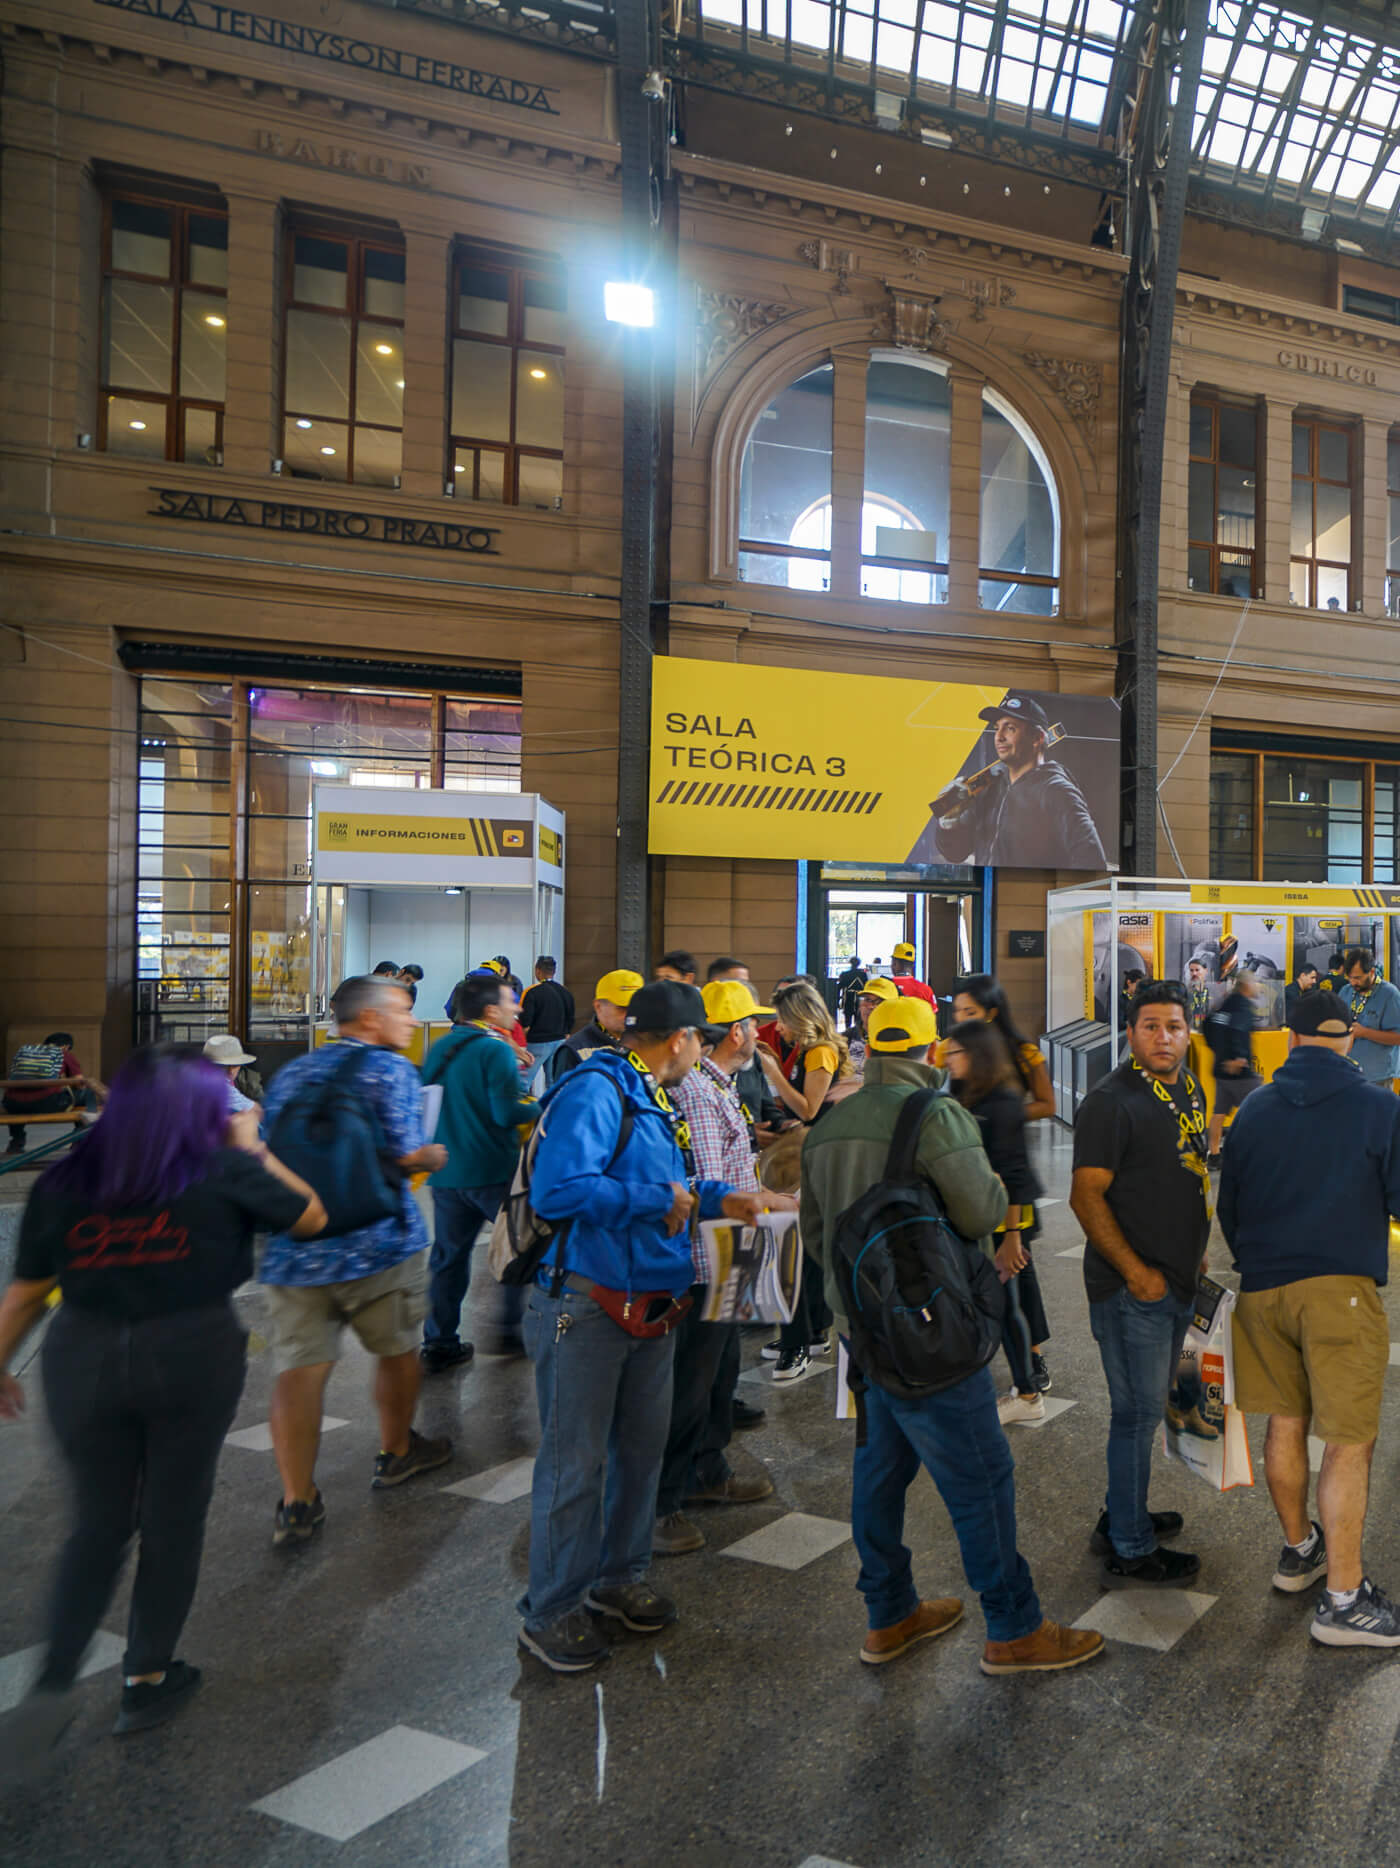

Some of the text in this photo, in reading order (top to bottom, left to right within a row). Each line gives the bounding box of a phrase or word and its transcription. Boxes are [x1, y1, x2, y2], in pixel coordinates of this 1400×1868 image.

[97, 0, 551, 113] ALA TENNYSON FERRADA
[1277, 351, 1376, 387] CURICO
[157, 490, 492, 550] SALA PEDRO PRADO
[665, 712, 757, 739] SALA
[663, 743, 847, 777] TEÓRICA 3
[356, 829, 466, 840] INFORMACIONES
